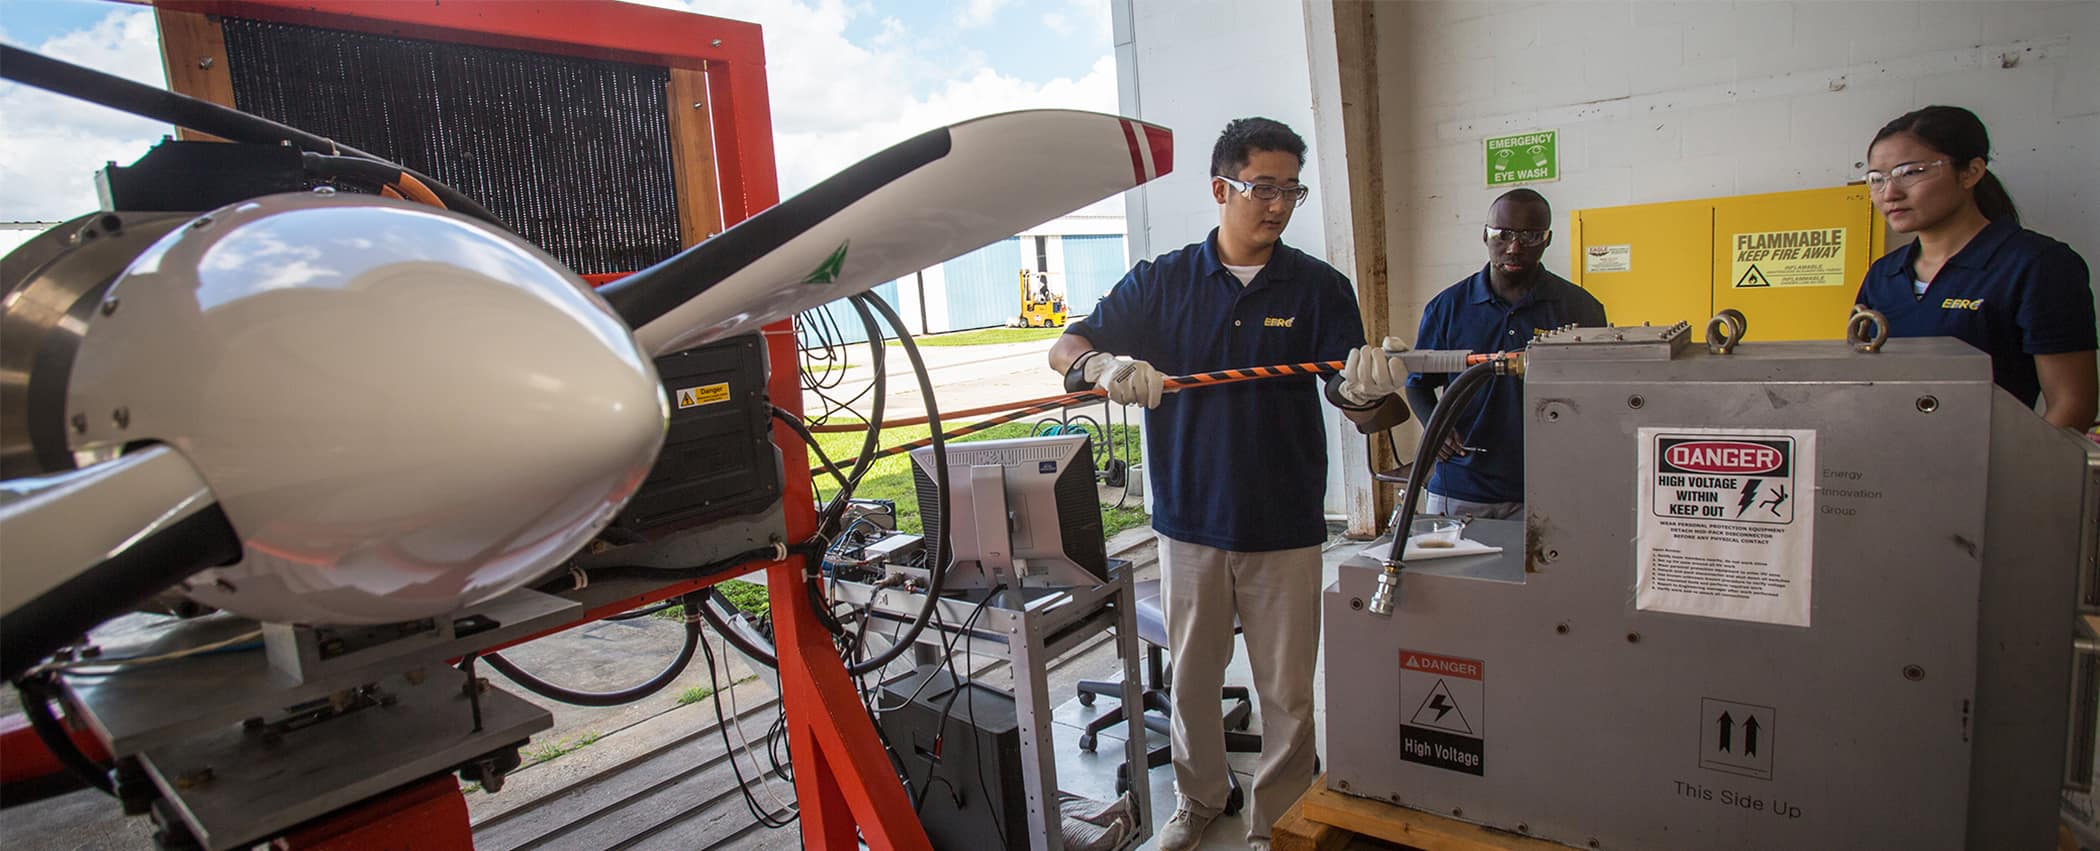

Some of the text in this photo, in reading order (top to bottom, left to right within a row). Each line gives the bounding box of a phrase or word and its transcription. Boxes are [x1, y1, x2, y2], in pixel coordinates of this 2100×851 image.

[1489, 133, 1553, 150] EMERGENCY
[1494, 168, 1548, 182] EYE WASH
[1737, 230, 1842, 250] FLAMMABLE
[1737, 246, 1841, 262] KEEP FIRE AWAY
[1673, 447, 1774, 468] DANGER
[1658, 475, 1737, 489] HIGH VOLTAGE
[1823, 469, 1863, 480] Energy
[1676, 490, 1718, 502] WITHIN
[1822, 488, 1882, 498] Innovation
[1670, 504, 1725, 517] KEEP OUT
[1821, 504, 1857, 516] Group
[1421, 658, 1477, 675] DANGER
[1404, 738, 1479, 767] High Voltage
[1674, 780, 1802, 819] This Side Up
